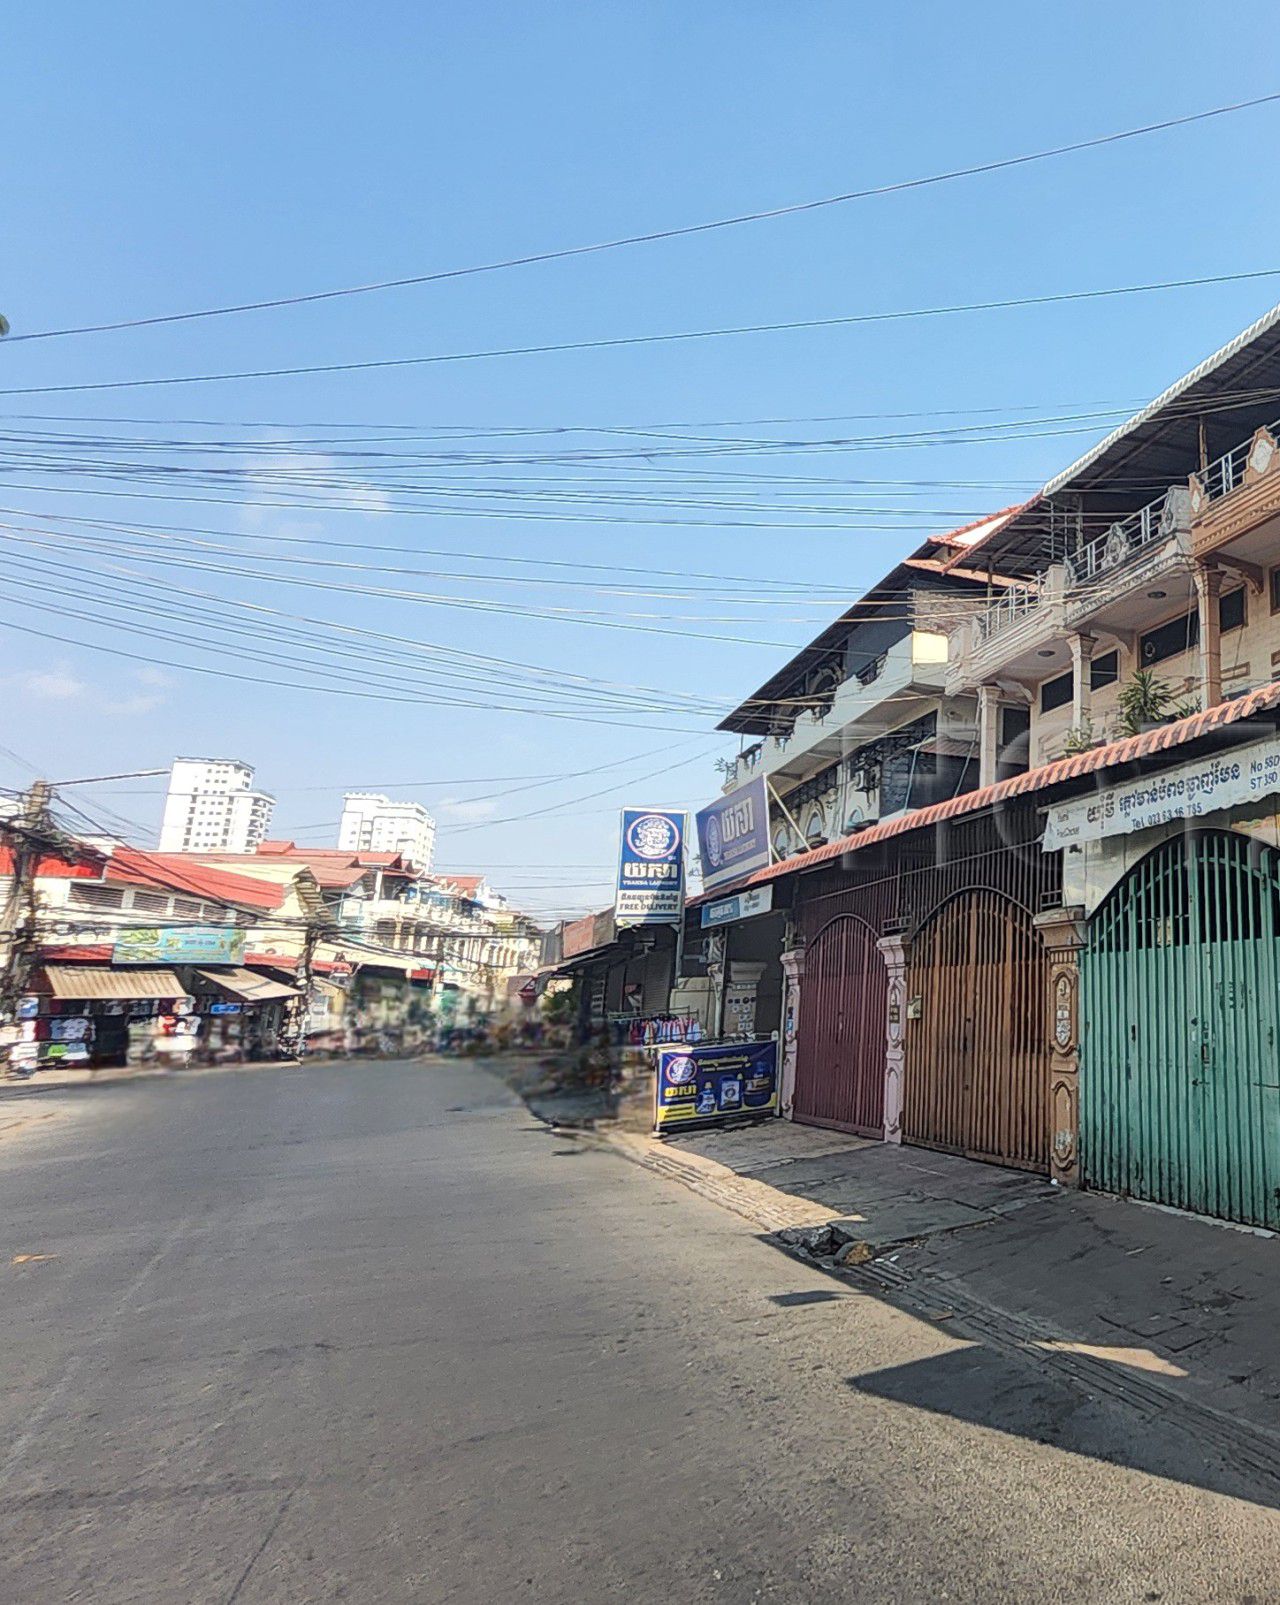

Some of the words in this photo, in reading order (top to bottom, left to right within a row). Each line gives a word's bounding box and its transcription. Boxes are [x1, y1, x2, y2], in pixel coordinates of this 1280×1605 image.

[1250, 760, 1263, 774] No
[1250, 776, 1263, 790] ST
[1131, 816, 1145, 828] Tel
[619, 903, 639, 911] FREE
